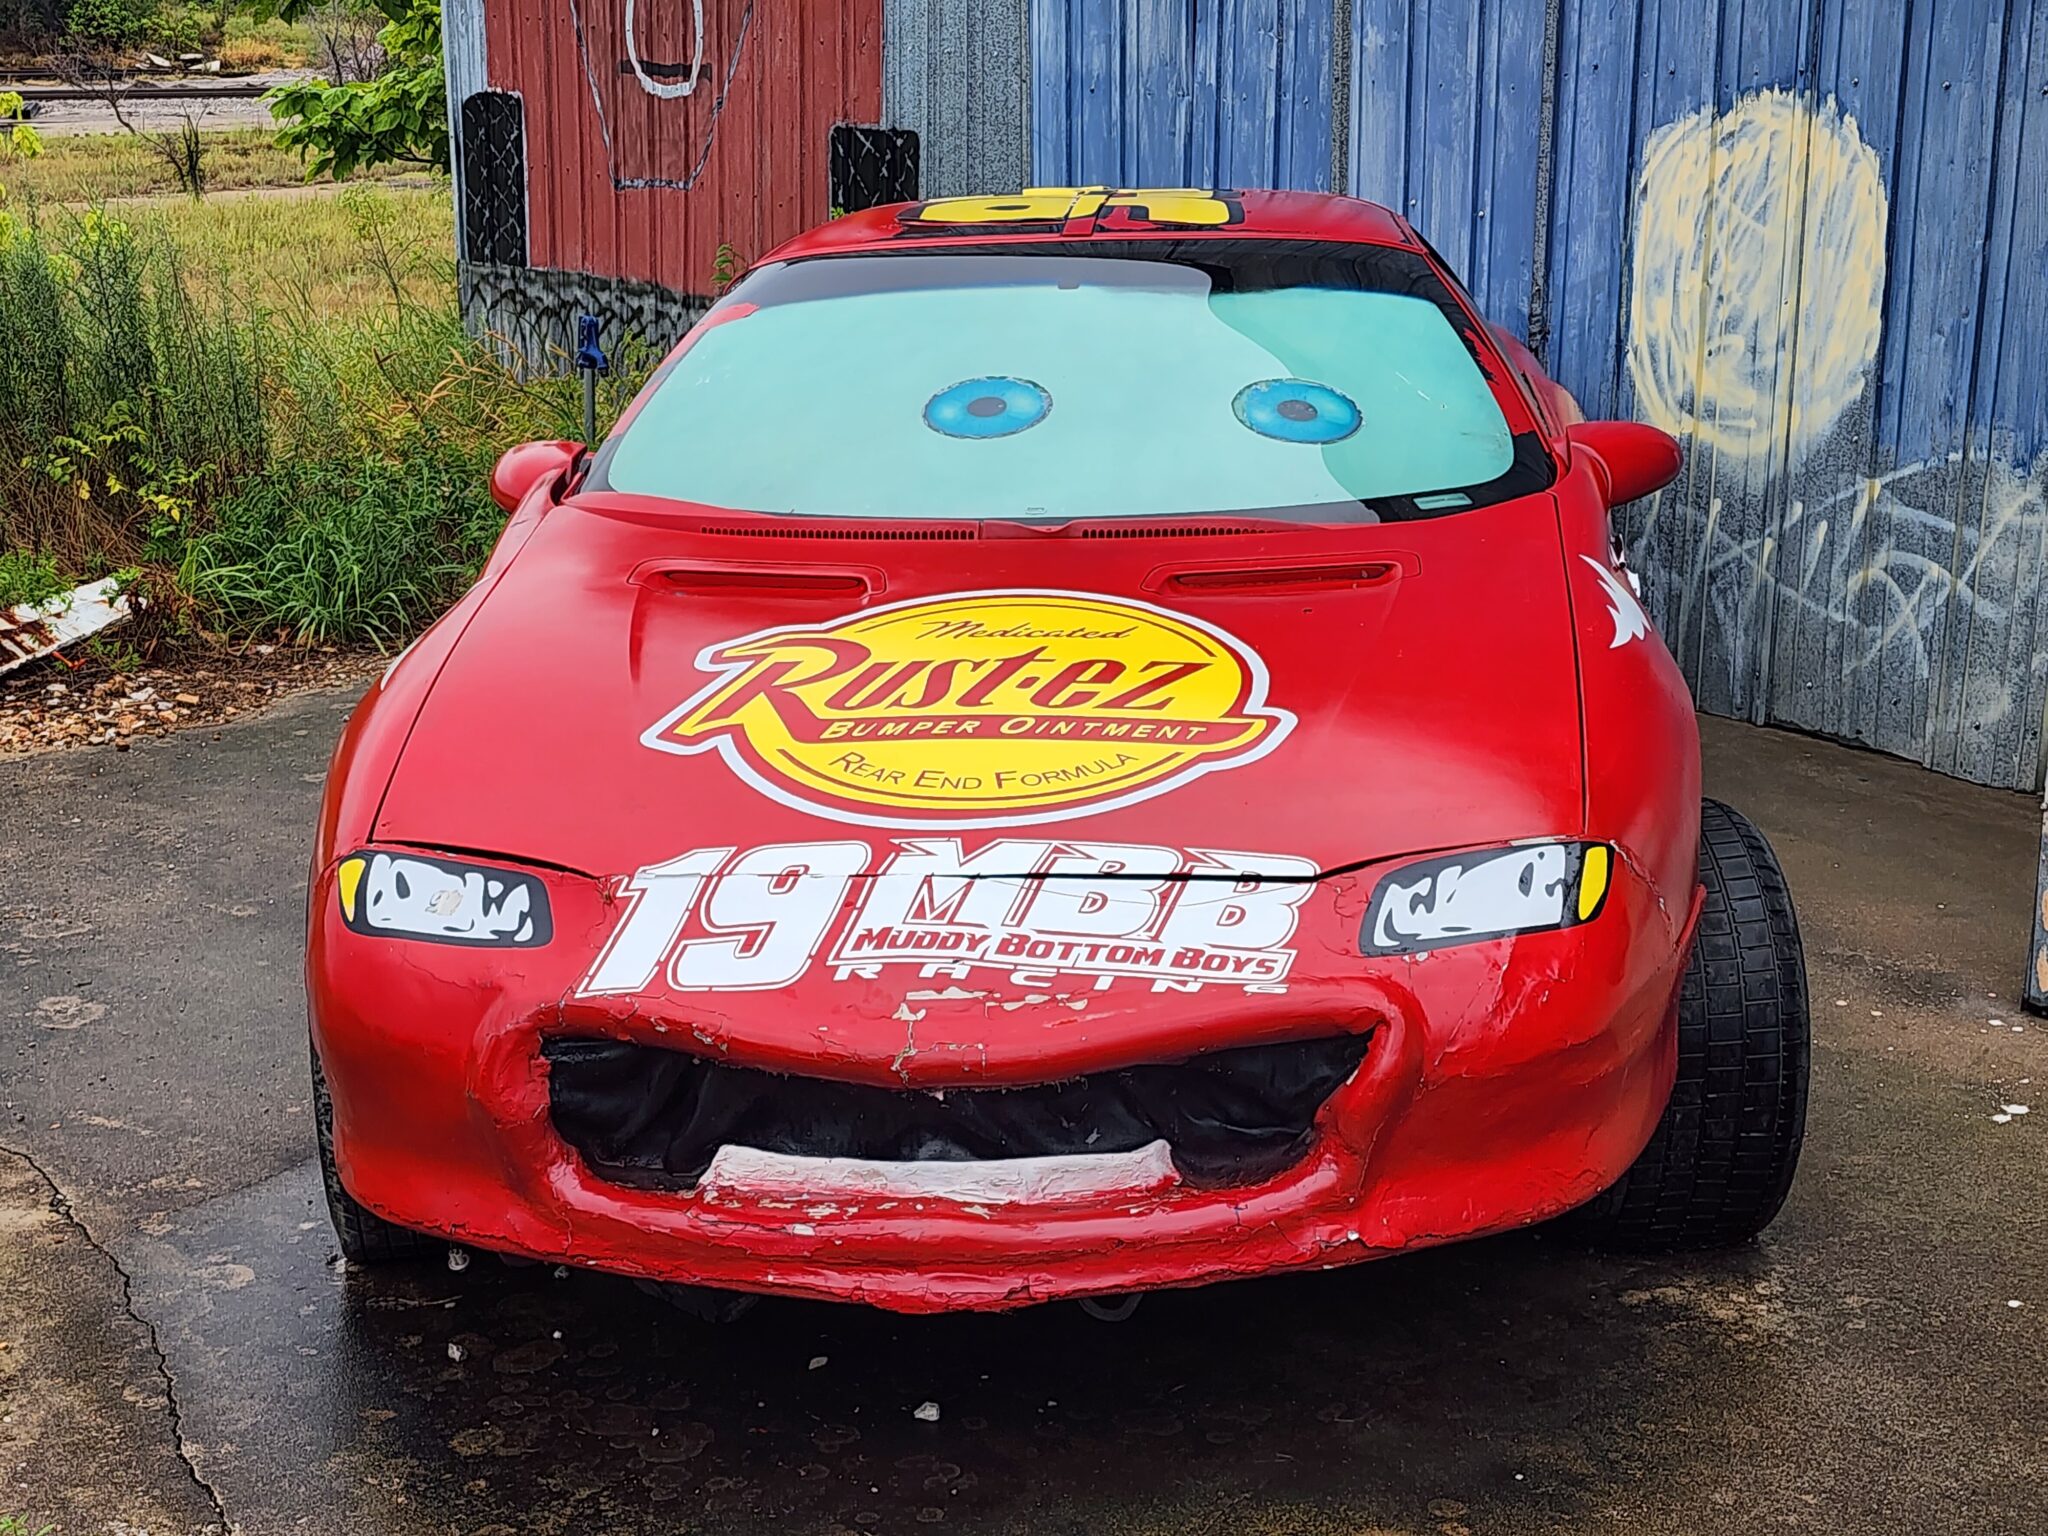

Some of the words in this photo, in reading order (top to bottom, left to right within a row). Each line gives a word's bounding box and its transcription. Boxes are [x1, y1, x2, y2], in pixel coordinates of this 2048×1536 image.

[915, 620, 1139, 639] Medicated
[820, 719, 982, 739] BUMPER
[1000, 717, 1207, 740] OINTMENT
[828, 751, 906, 785] REAR
[914, 770, 982, 790] END
[994, 753, 1139, 790] FORMULA
[574, 841, 873, 998] 19
[850, 838, 1321, 950] MBB
[852, 926, 991, 953] MUDDY
[994, 932, 1166, 966] BOTTOM
[1170, 947, 1279, 975] BOYS
